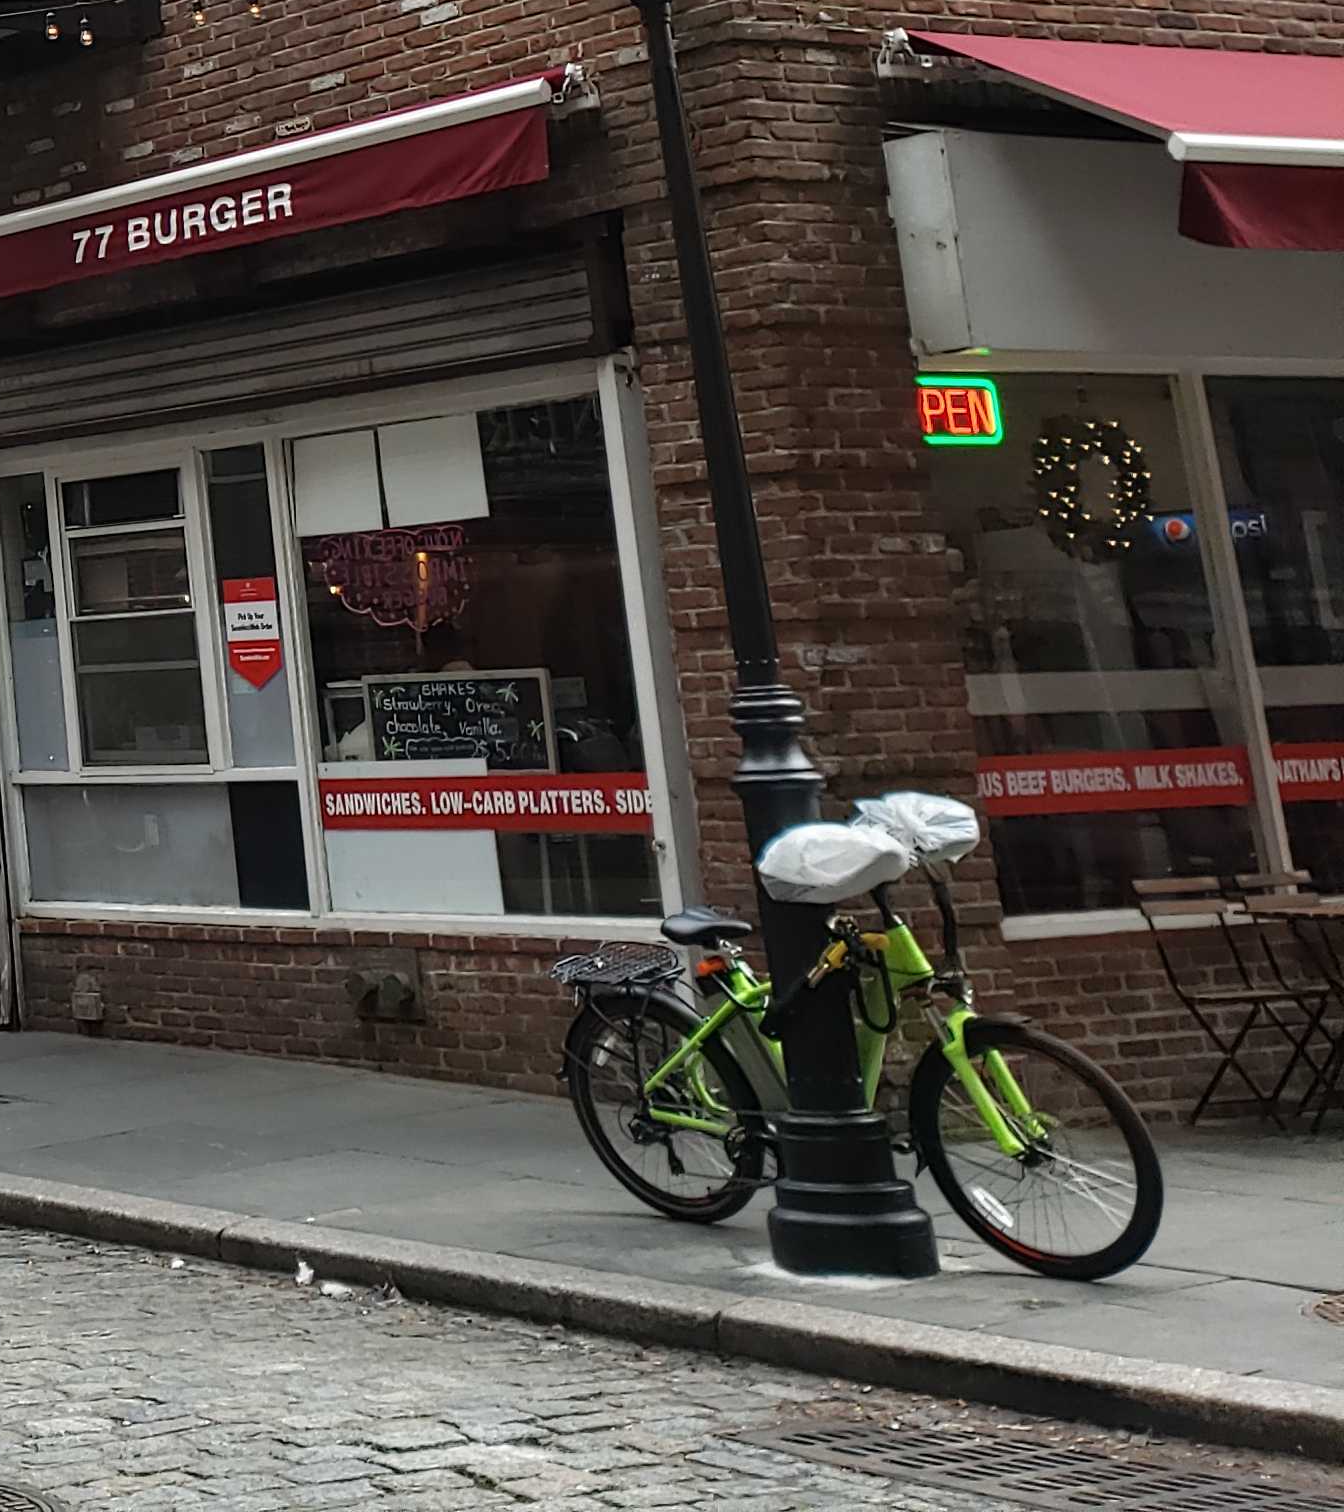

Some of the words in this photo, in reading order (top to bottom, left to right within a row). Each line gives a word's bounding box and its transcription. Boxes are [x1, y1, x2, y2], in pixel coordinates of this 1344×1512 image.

[72, 224, 114, 264] 77
[127, 182, 294, 253] BURGER
[918, 388, 997, 436] PEN
[421, 680, 477, 697] SHAKES
[1005, 770, 1047, 797] BEEF
[1051, 766, 1131, 794] BURGERS.
[1135, 764, 1174, 789] MILK
[1174, 760, 1244, 788] SHAKES.
[324, 791, 426, 817] SANDWICHES.
[430, 790, 516, 816] LOW-CARB
[518, 789, 611, 815] PLATTERS.
